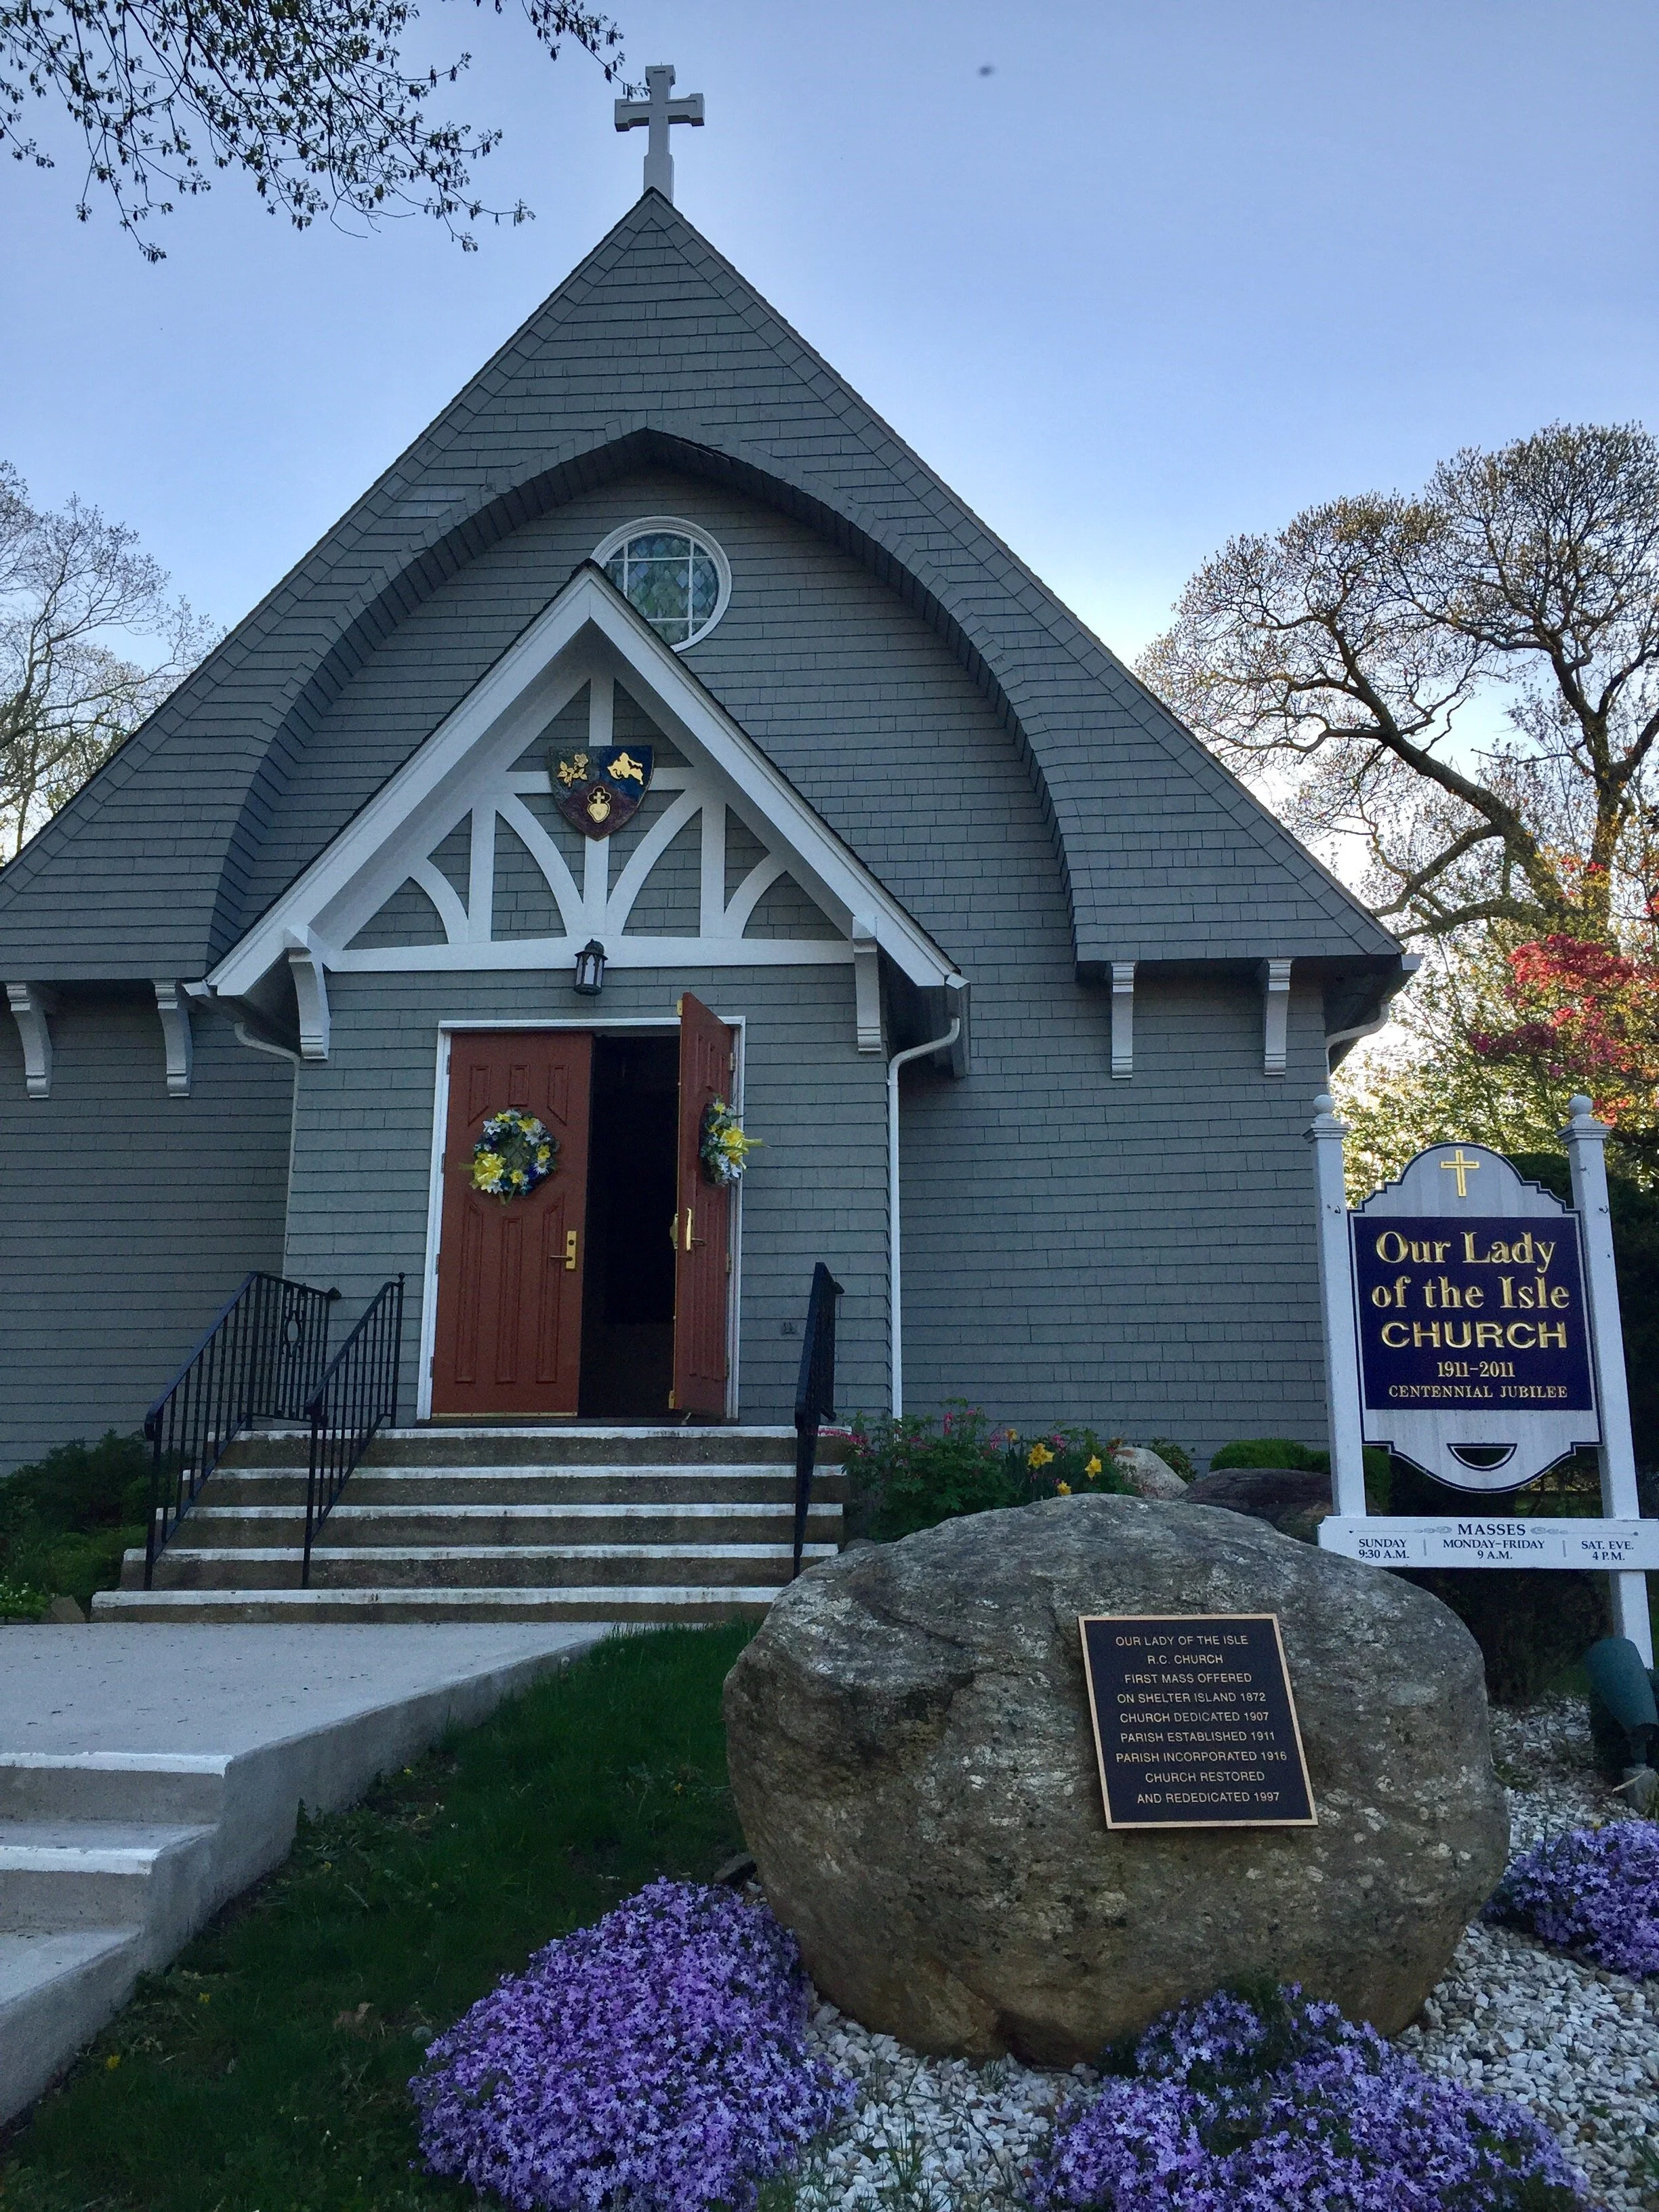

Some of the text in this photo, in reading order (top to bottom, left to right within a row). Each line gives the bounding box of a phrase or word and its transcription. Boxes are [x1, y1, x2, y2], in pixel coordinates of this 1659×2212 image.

[1376, 1231, 1556, 1273] Our Lady
[1372, 1276, 1569, 1309] of the Isle
[1381, 1322, 1567, 1349] CHURCH
[1437, 1361, 1515, 1378] 1911-2011
[1389, 1385, 1568, 1399] CENTENNIAL JUBILEE
[1458, 1523, 1526, 1536] MASSES
[1359, 1539, 1407, 1548] SUNDAY
[1443, 1540, 1544, 1549] MONDAY-FRIDAY
[1581, 1540, 1634, 1550] SAT. EVE.
[1358, 1550, 1410, 1559] 9:30 A.M.
[1477, 1550, 1513, 1559] 9 A.M.
[1592, 1551, 1626, 1561] 4 P.M.
[1115, 1635, 1248, 1646] OUR LADY OF THE ISLE
[1147, 1654, 1223, 1664] R.C. CHURCH
[1124, 1673, 1252, 1684] FIRST MASS OFFERED
[1118, 1692, 1266, 1704] ON SHELTER ISLAND 1872
[1120, 1712, 1269, 1723] CHURCH DEDICATED 1907
[1121, 1732, 1275, 1742] PARISH ESTABLISHED 1911
[1116, 1750, 1287, 1763] PARISH INCORPORATED 1916
[1145, 1771, 1265, 1783] CHURCH RESTORED
[1137, 1791, 1279, 1804] AND REDEDICATED 1997
